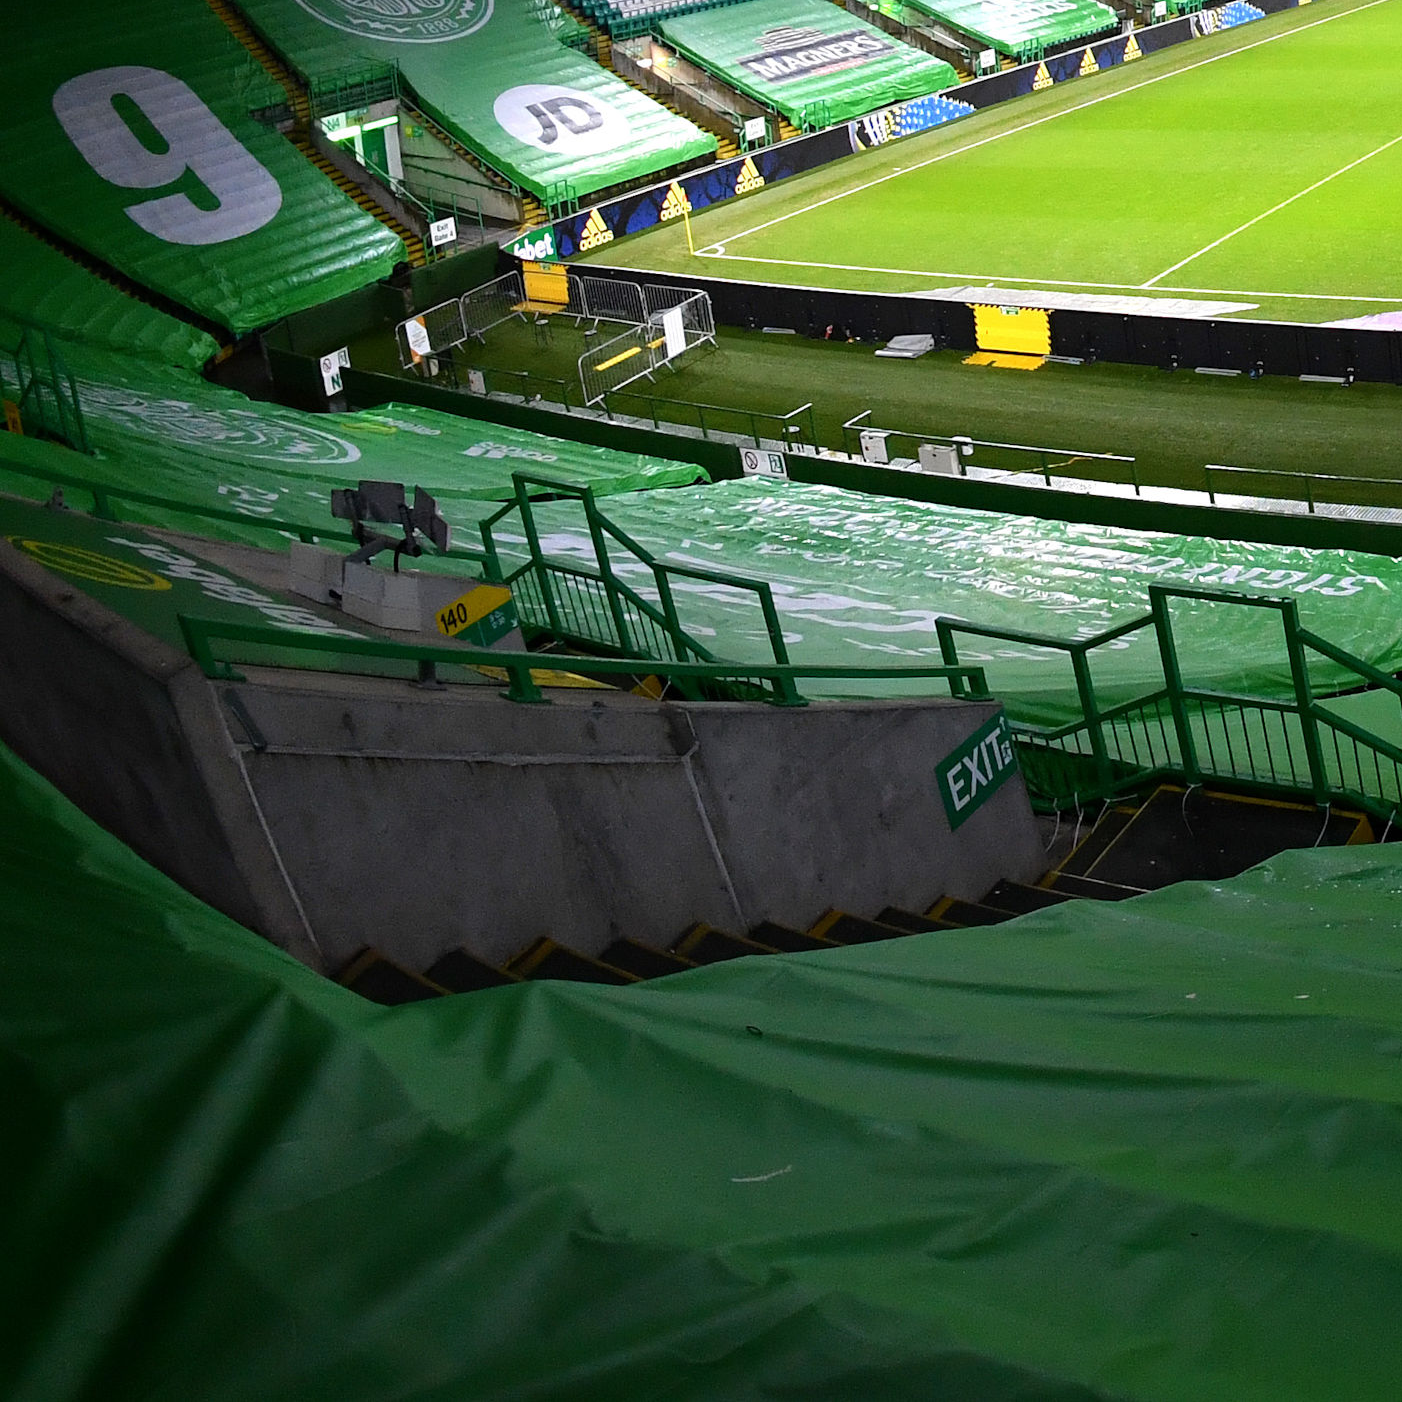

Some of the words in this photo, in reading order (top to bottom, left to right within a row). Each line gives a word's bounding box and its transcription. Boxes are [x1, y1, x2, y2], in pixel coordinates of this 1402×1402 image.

[416, 19, 459, 35] 1888
[748, 35, 884, 78] MAGNERS
[525, 96, 604, 146] JD
[52, 66, 283, 245] 9
[735, 176, 765, 195] adidas
[660, 201, 692, 221] adidas
[437, 222, 449, 233] Exit
[579, 229, 614, 252] adidas
[440, 602, 467, 634] 140
[946, 726, 1004, 812] EXIT
